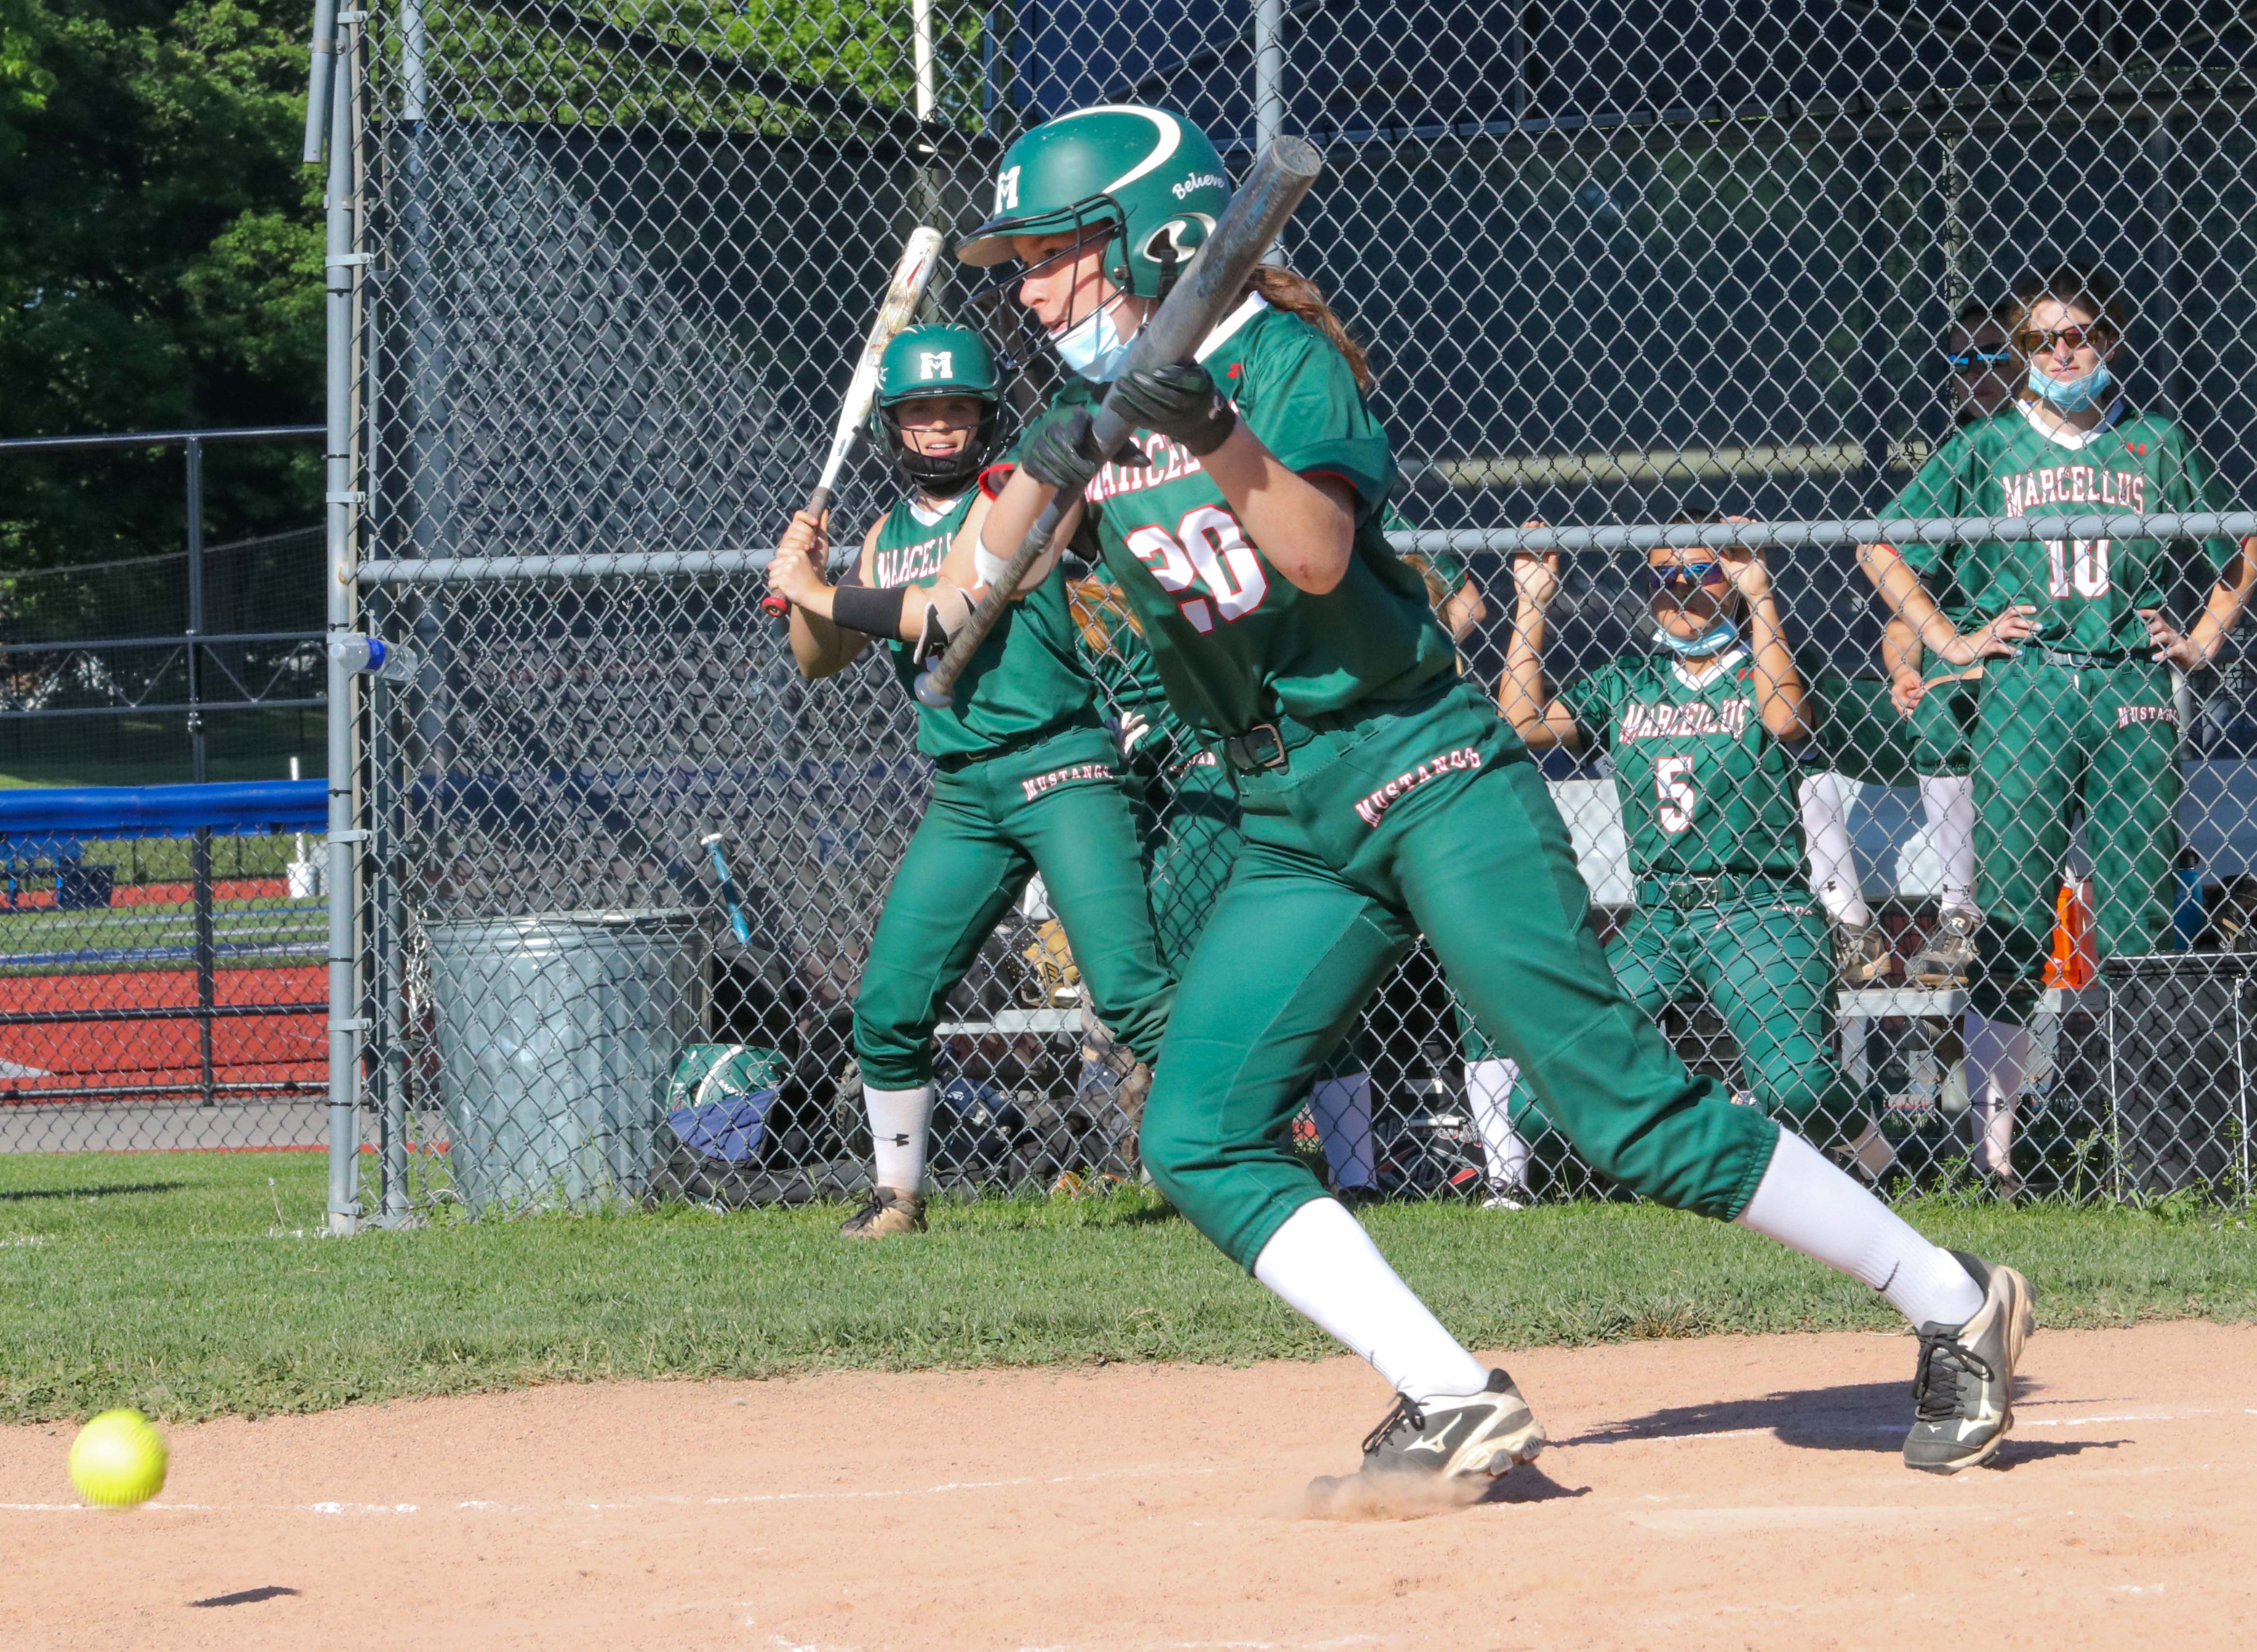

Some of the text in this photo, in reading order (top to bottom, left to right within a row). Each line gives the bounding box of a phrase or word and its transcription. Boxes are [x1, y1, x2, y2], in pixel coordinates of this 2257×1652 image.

[1172, 171, 1225, 200] Believe
[920, 352, 953, 380] M
[2001, 465, 2145, 517] MARCELLUS
[1124, 504, 1269, 635] 20
[2044, 539, 2111, 599] 10
[1619, 698, 1751, 744] MARCELLUS
[2117, 705, 2178, 729] MUSTAN
[1354, 745, 1482, 828] MUSTANGS
[1655, 755, 1695, 832] 5
